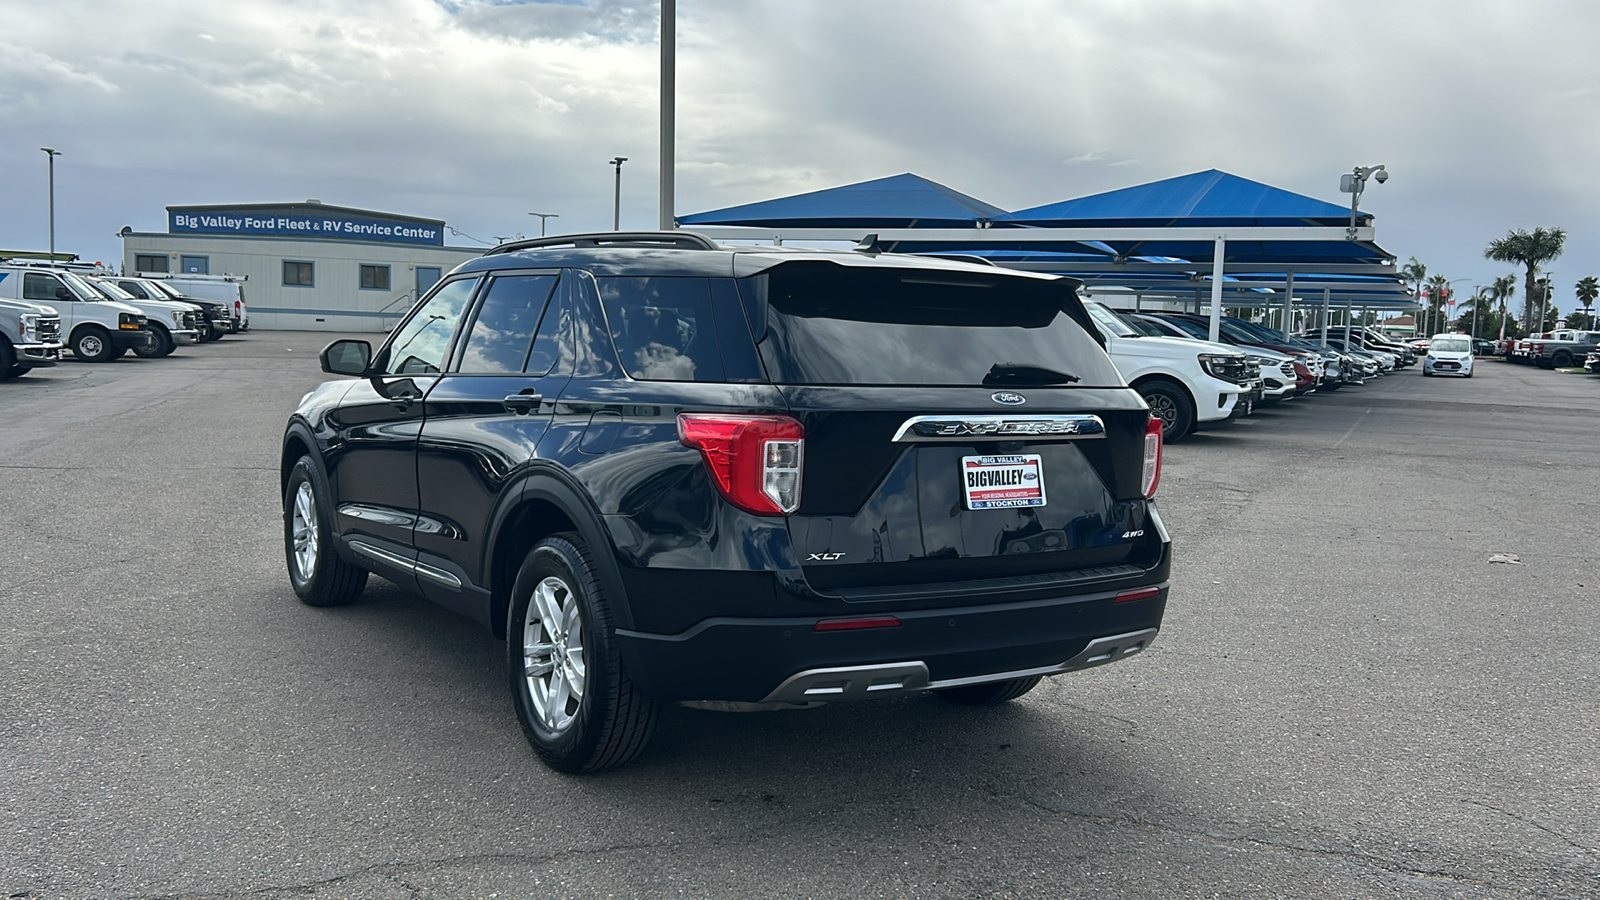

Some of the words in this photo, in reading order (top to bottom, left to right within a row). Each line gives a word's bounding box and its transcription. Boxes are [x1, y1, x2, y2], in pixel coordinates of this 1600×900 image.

[175, 215, 198, 228] Big
[201, 216, 242, 229] Valley
[245, 218, 275, 229] Ford
[278, 218, 311, 231] Fleet
[323, 221, 342, 232] RV
[344, 222, 391, 235] Service
[394, 226, 436, 239] Center
[937, 420, 1081, 435] EXPLORER
[967, 469, 1023, 488] BIGVALLEY
[986, 499, 1029, 507] STOCKTON
[1121, 529, 1144, 539] 4WD
[805, 552, 846, 561] XLT
